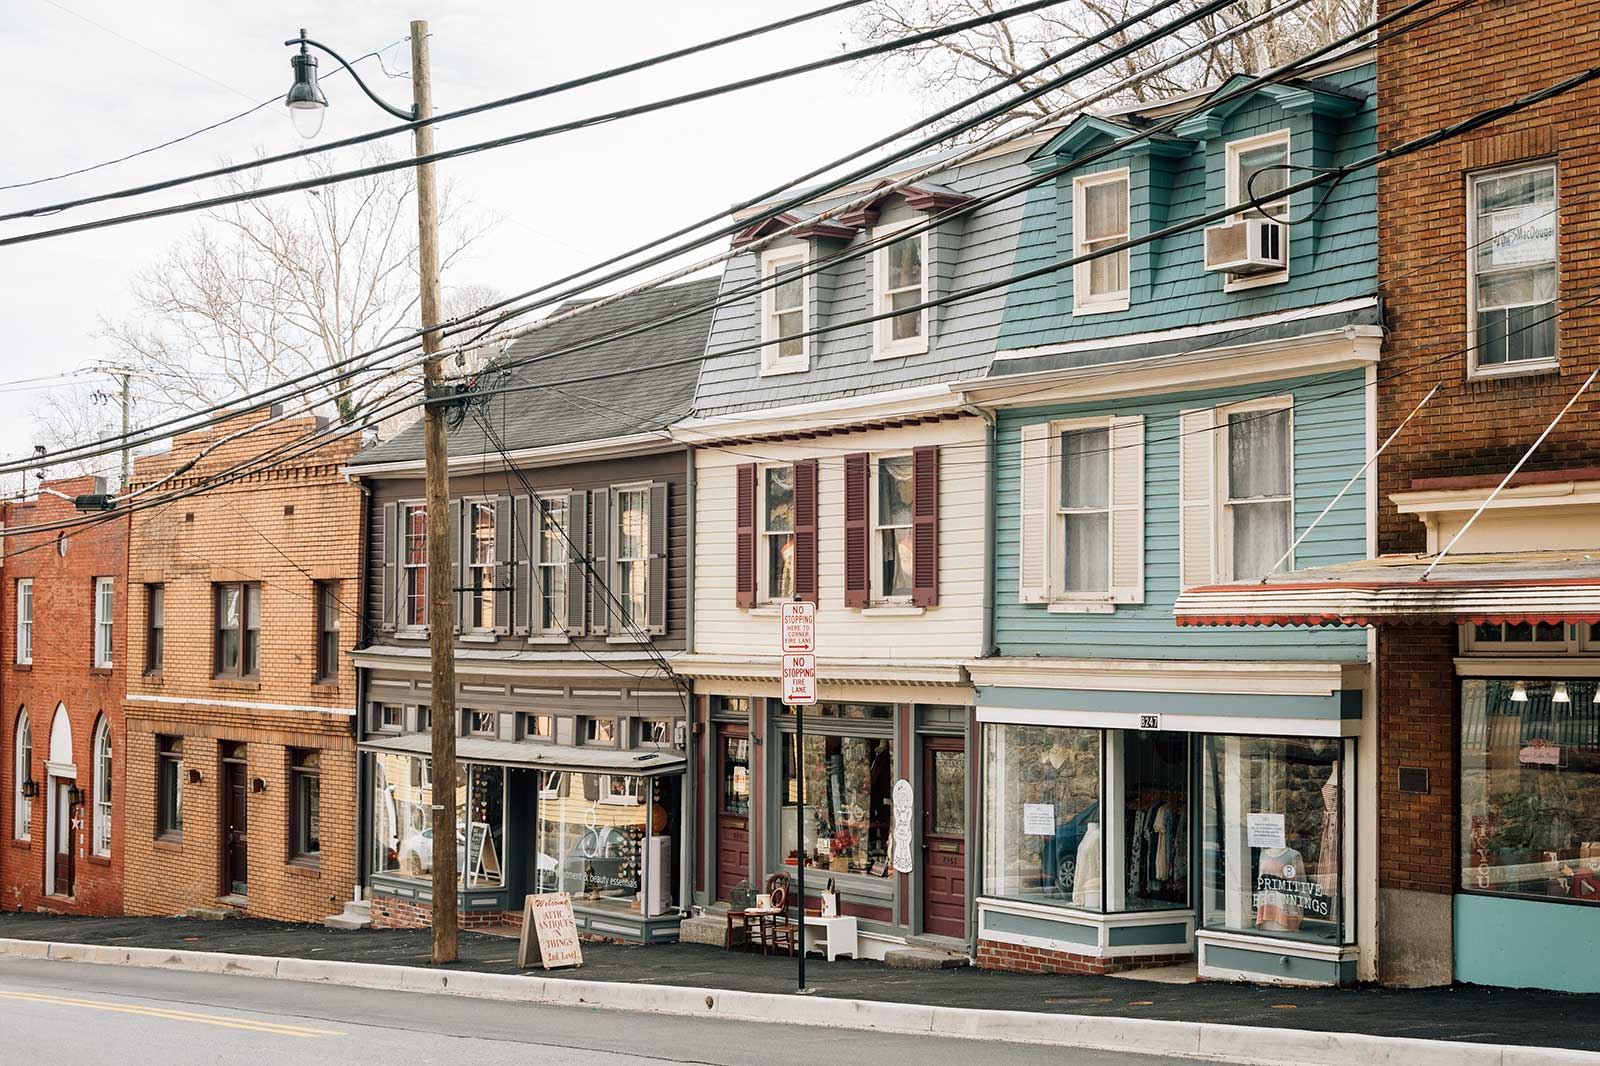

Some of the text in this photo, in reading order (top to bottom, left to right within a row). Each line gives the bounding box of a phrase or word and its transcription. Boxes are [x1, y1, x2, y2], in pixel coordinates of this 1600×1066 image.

[792, 606, 804, 615] NO
[784, 615, 813, 624] STOPPING
[792, 657, 805, 667] NO
[784, 668, 814, 678] STOPPING
[791, 686, 807, 694] LANE
[1141, 716, 1158, 728] 8247
[590, 873, 610, 887] beauty
[610, 877, 638, 889] essentials
[1256, 877, 1323, 897] PRIMITIVE
[535, 899, 568, 907] Welcome
[1253, 893, 1328, 916] BEGNNINGS
[543, 910, 564, 920] ATTIC
[538, 919, 574, 930] ANTIQUES
[546, 938, 574, 949] THINGS
[547, 950, 577, 961] 2nd Level
